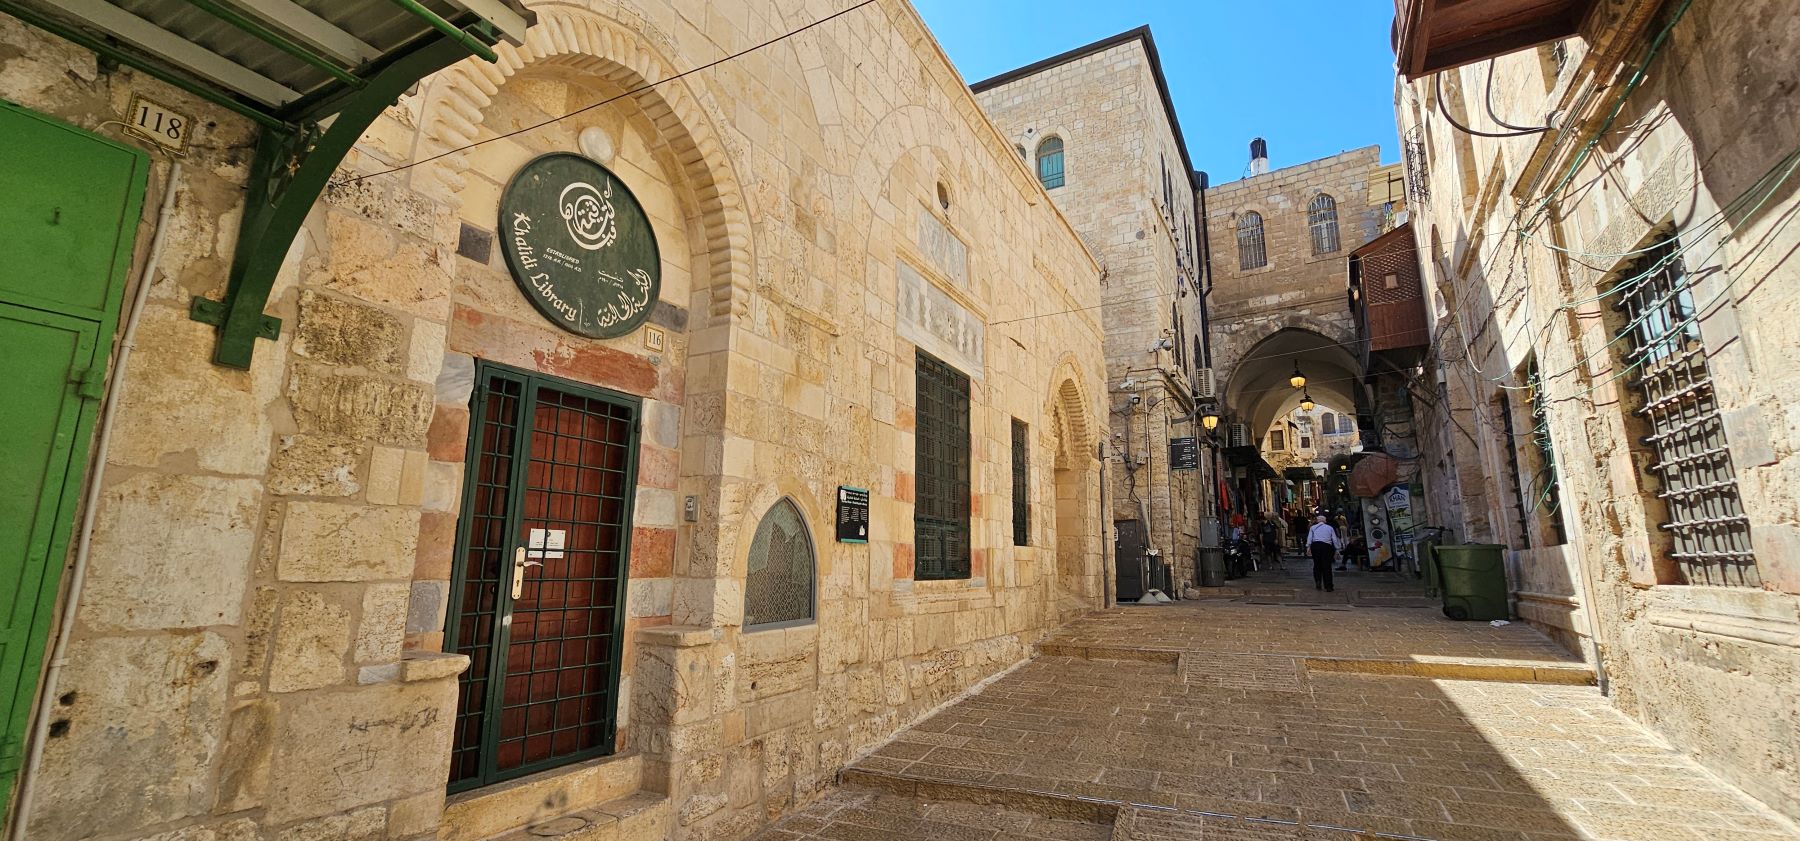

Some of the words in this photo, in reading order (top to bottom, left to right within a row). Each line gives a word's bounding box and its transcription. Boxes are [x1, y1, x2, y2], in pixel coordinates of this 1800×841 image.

[137, 106, 182, 140] 118
[513, 212, 538, 271] Khalidi
[529, 272, 577, 322] Library
[546, 247, 580, 264] ESTABLISHED
[648, 331, 662, 346] 116
